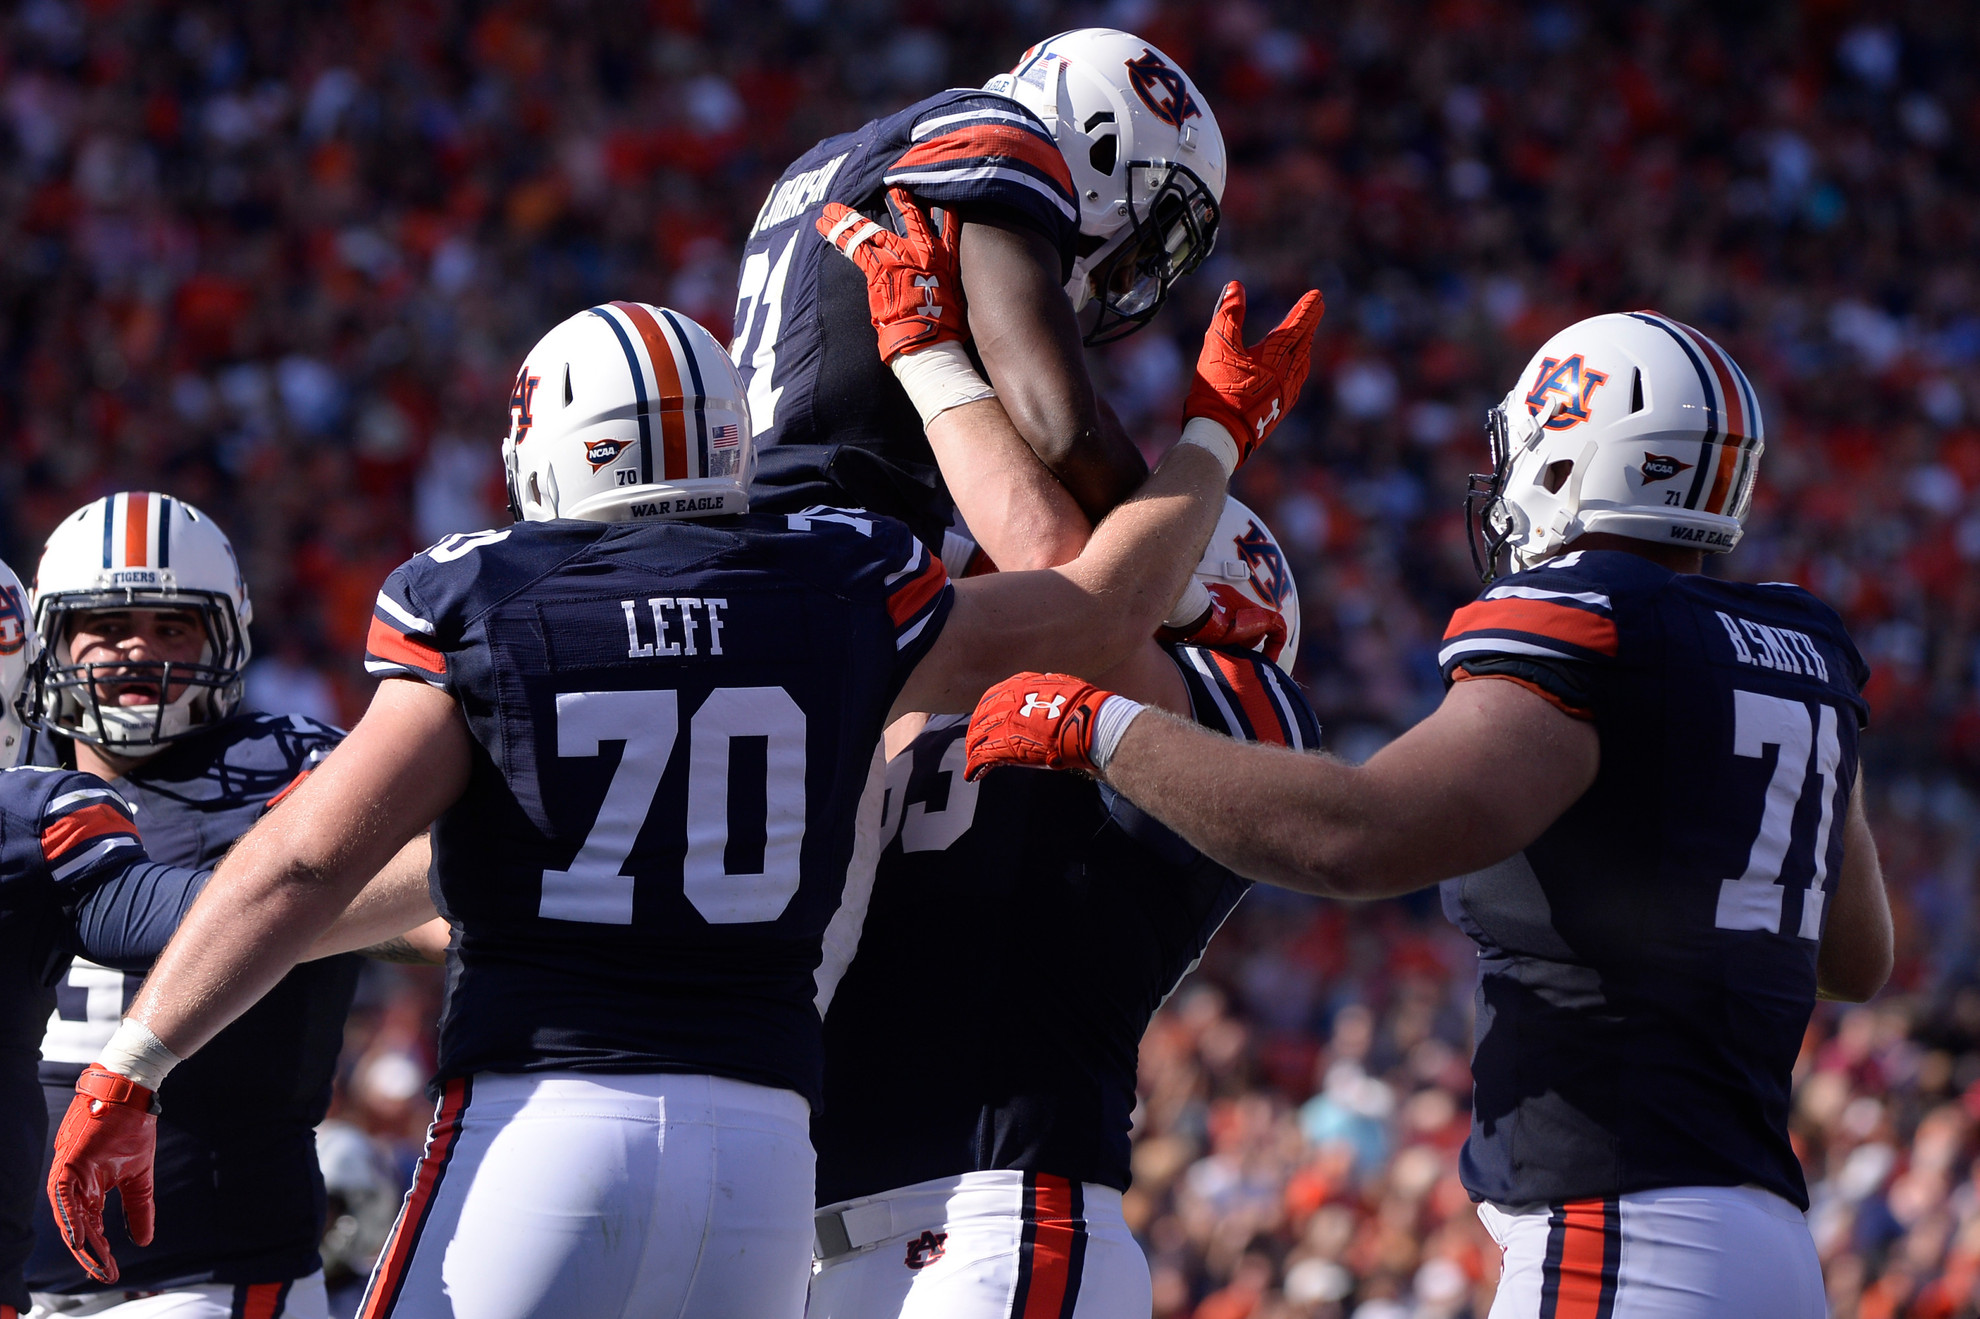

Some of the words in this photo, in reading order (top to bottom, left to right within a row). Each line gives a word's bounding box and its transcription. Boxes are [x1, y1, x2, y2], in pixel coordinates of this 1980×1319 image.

[589, 446, 615, 459] NCAA
[1645, 462, 1674, 474] NCAA
[616, 469, 638, 486] 70
[1664, 489, 1681, 506] 71
[631, 501, 671, 518] WAR
[675, 496, 724, 513] EAGLE
[1670, 525, 1706, 542] WAR
[113, 571, 156, 584] TIGERS
[620, 598, 728, 658] LEFF
[1715, 610, 1830, 683] B.SMITH
[538, 686, 807, 925] 70
[1715, 689, 1841, 941] 71
